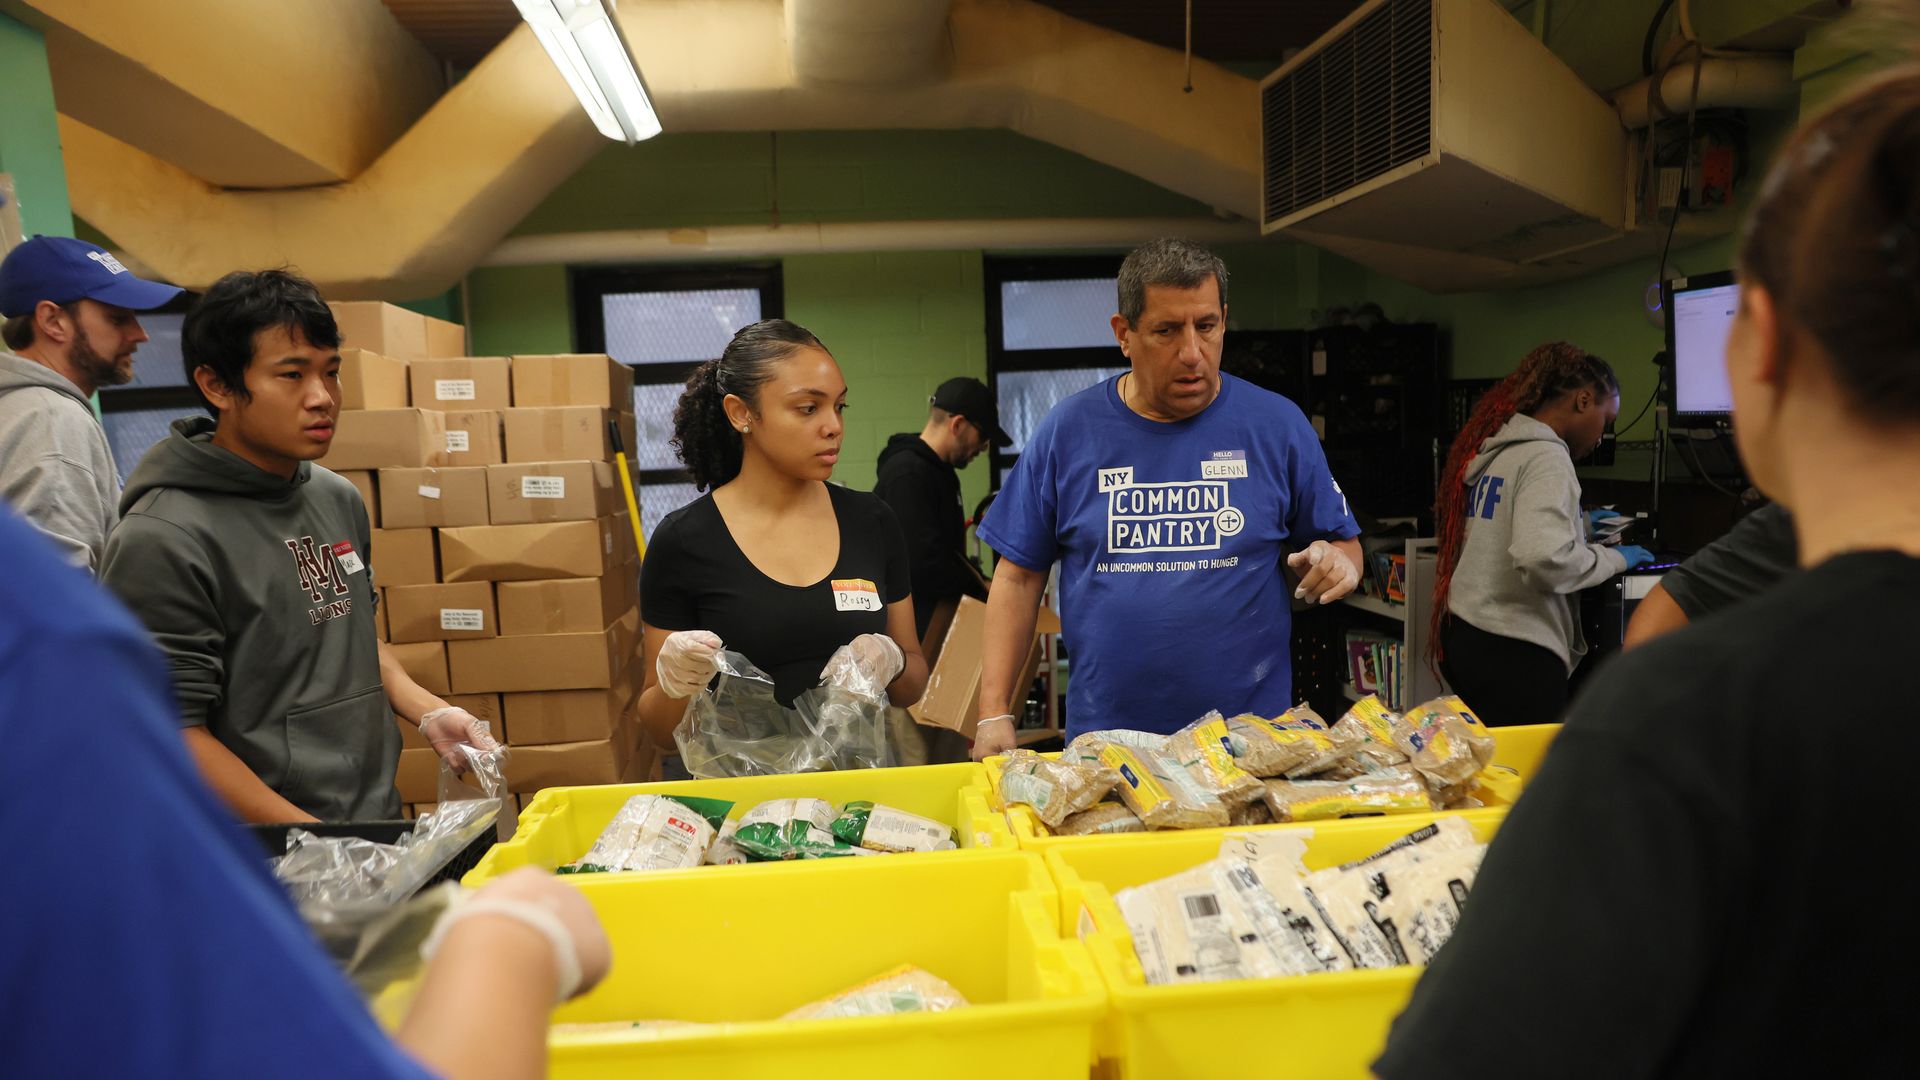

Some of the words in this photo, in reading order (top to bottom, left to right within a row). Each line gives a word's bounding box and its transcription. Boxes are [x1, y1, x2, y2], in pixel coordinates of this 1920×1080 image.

[1103, 471, 1129, 487] NY
[1204, 465, 1245, 476] GLENN
[1116, 486, 1220, 514] COMMON
[1116, 519, 1211, 548] PANTRY
[1096, 562, 1108, 573] AN
[1110, 561, 1154, 573] UNCOMMON
[1156, 560, 1196, 572] SOLUTION
[1198, 559, 1209, 570] TO
[1211, 556, 1239, 569] HUNGER
[308, 598, 352, 626] LIONS
